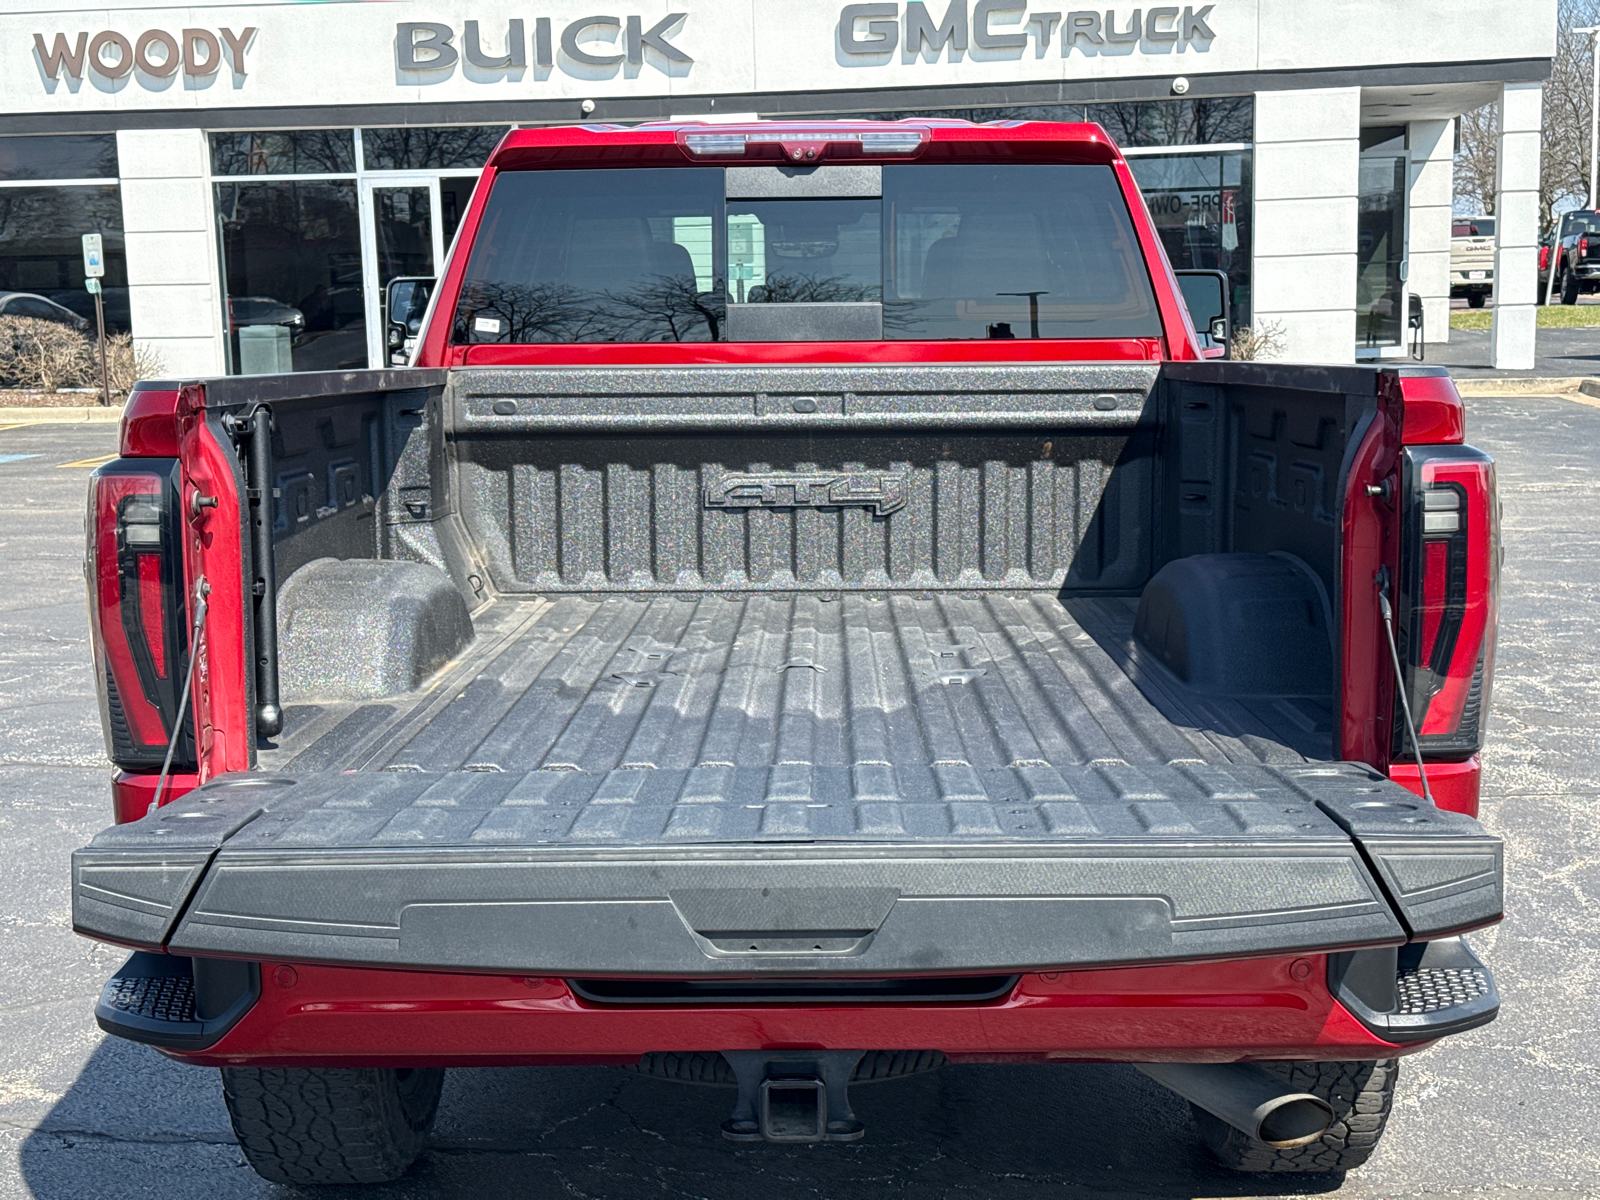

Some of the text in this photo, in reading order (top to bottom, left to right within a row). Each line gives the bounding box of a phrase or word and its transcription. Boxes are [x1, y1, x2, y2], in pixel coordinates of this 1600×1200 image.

[32, 27, 257, 79] WOODY
[396, 12, 694, 70] BUICK
[839, 0, 1216, 54] GMC TRUCK
